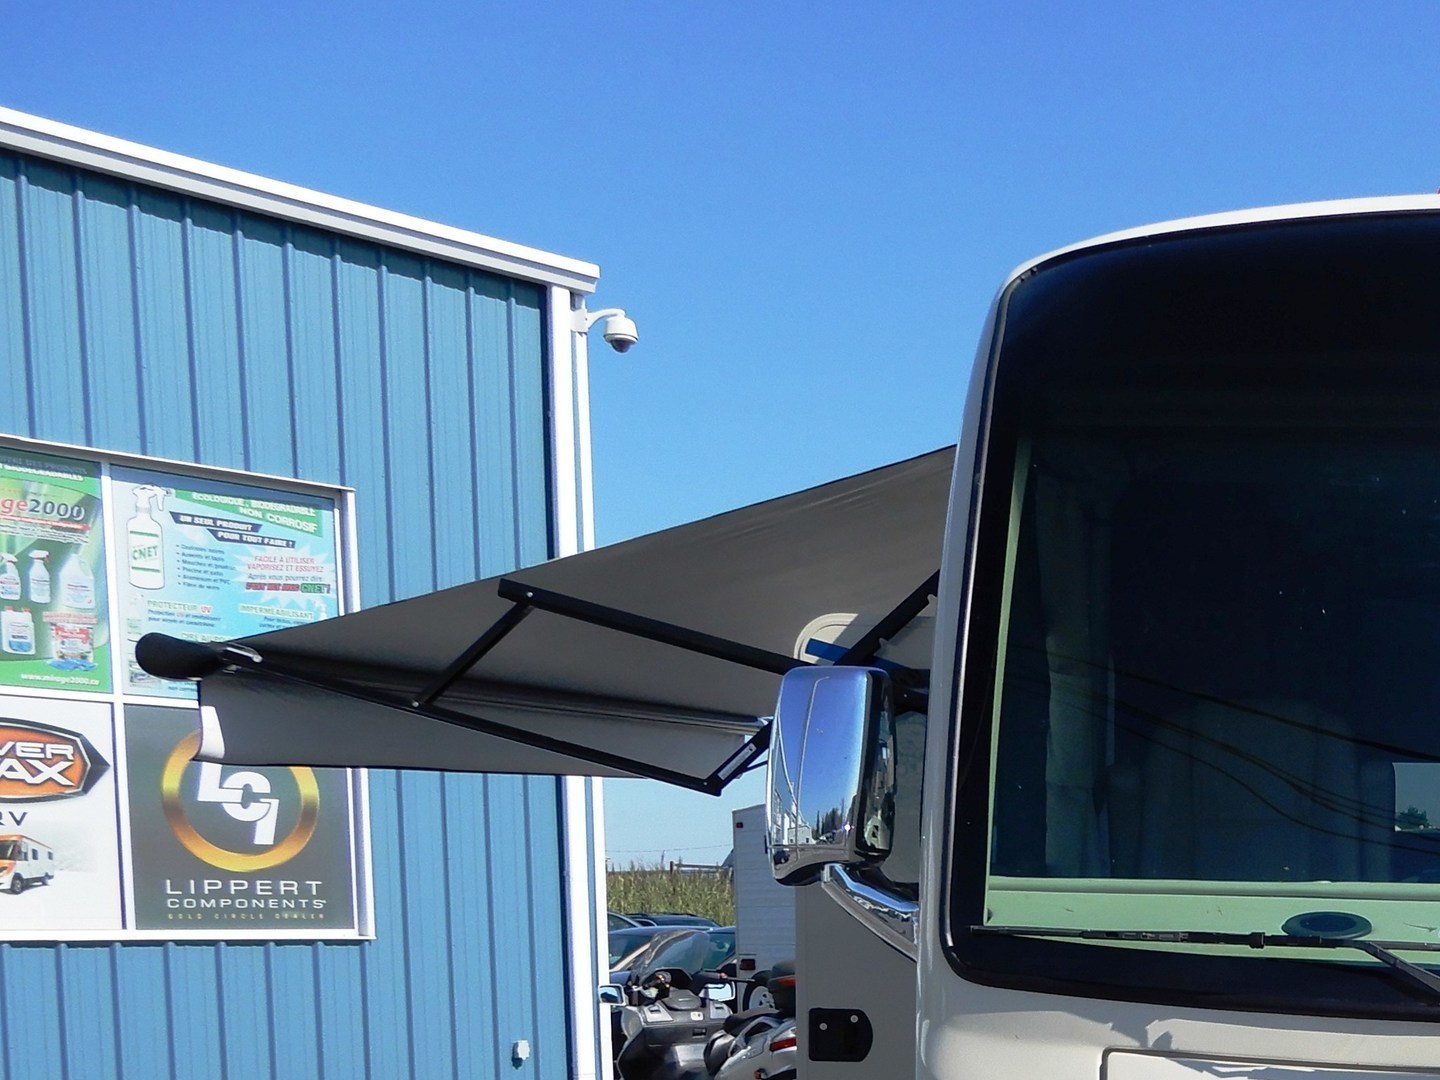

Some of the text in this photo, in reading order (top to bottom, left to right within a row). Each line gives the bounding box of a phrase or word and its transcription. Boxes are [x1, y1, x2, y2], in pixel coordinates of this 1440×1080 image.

[194, 517, 215, 526] SEUL
[217, 520, 253, 531] PRODUIT
[239, 507, 318, 533] NON CORROSIF
[218, 532, 240, 541] POUR
[242, 534, 263, 543] TOUT
[264, 537, 287, 547] FAIRE
[132, 545, 158, 561] CNET
[254, 555, 277, 563] FACILE
[286, 557, 315, 565] UTILISER
[247, 563, 283, 572] VAPORISEZ
[295, 565, 324, 573] ESSUYEZ
[200, 605, 212, 614] UV
[165, 879, 323, 896] LIPPERT
[167, 898, 325, 909] COMPONENTS
